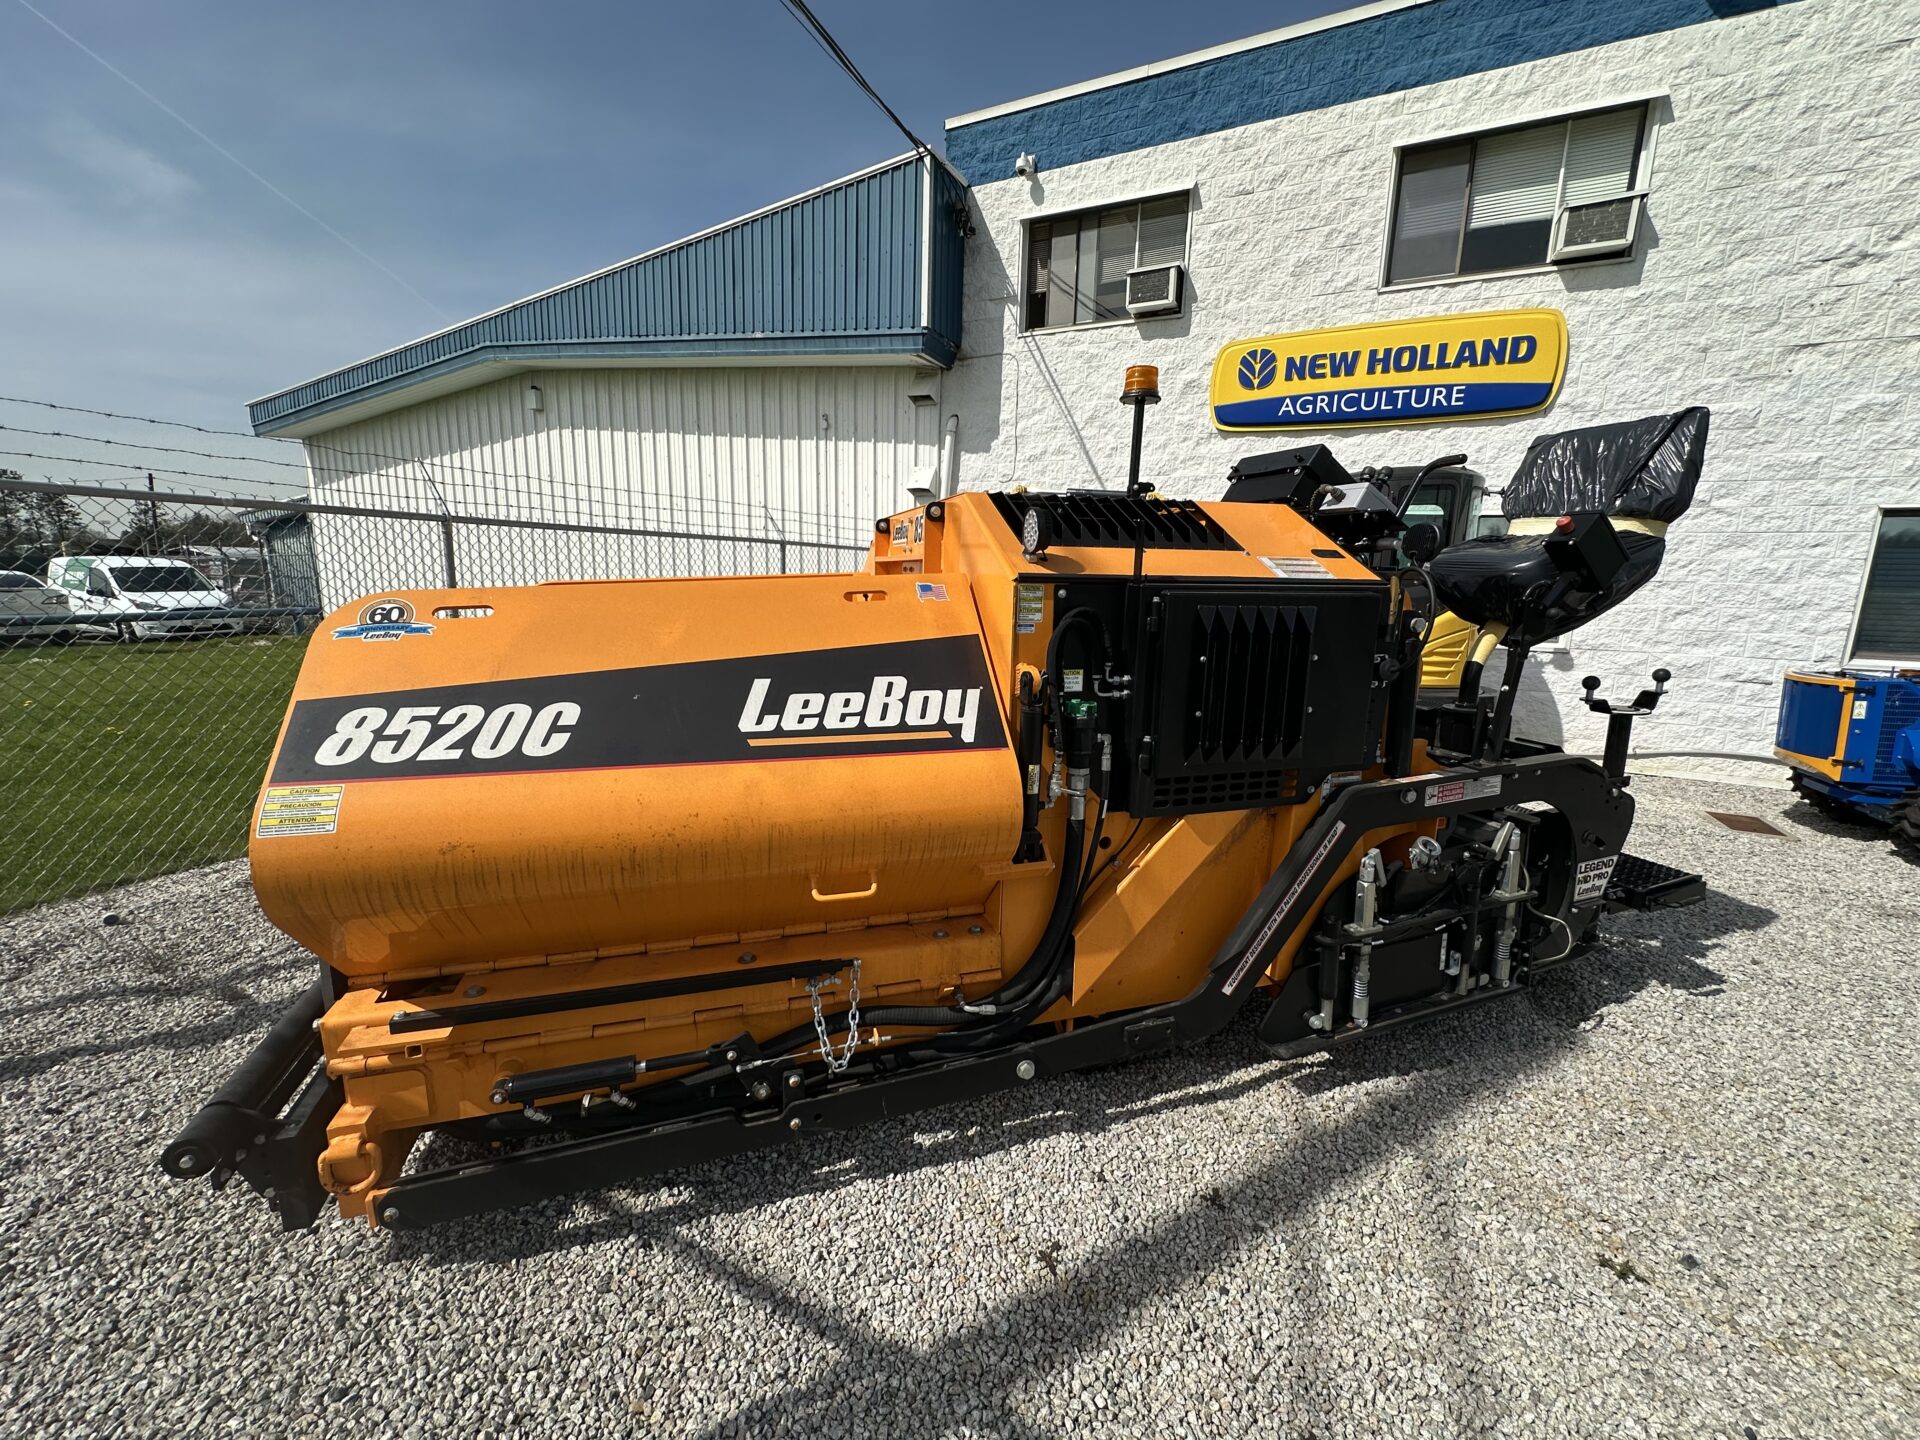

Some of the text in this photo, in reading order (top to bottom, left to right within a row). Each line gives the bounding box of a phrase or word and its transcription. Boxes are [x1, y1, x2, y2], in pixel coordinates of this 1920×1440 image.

[1284, 334, 1538, 381] NEW HOLLAND
[1278, 385, 1466, 416] AGRICULTURE
[368, 606, 406, 624] 60
[359, 624, 409, 632] ANNIVERSARY
[363, 631, 402, 640] LeeBoy
[738, 675, 982, 743] LeeBoy
[314, 701, 582, 766] 8520C
[1579, 858, 1614, 874] LEGEND
[1592, 870, 1609, 882] PRO
[1577, 883, 1603, 896] LeeBoy
[1249, 930, 1269, 958] DESIGNED
[1267, 917, 1278, 932] WITH
[1276, 906, 1285, 919] THE
[1296, 850, 1324, 888] PROFESSIONAL
